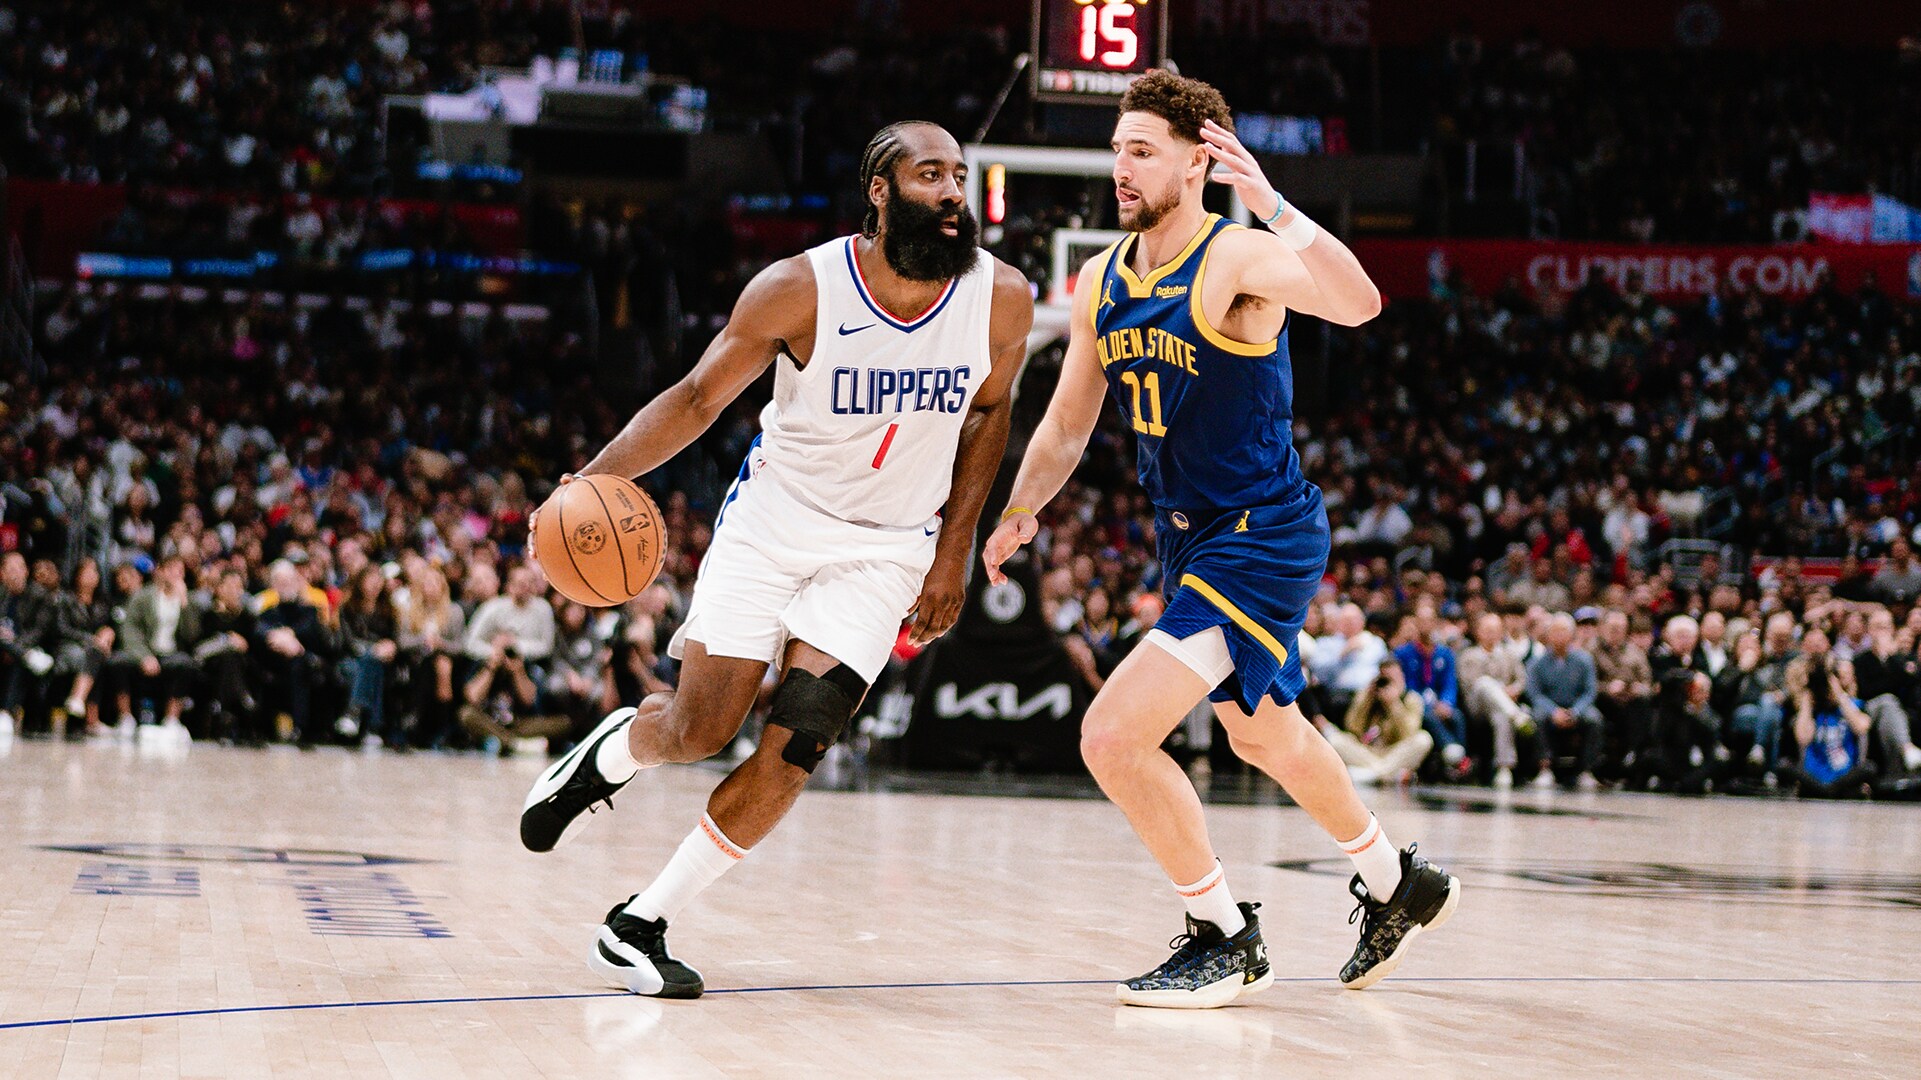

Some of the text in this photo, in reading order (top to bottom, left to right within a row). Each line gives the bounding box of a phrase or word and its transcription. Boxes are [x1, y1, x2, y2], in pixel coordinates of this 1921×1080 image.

[1079, 2, 1138, 67] 15
[1073, 70, 1144, 94] TISS
[1156, 285, 1188, 298] Rakuten
[1527, 255, 1829, 294] CLIPPERSCOM
[1096, 327, 1199, 376] OLDEN STATE
[830, 364, 971, 415] CLIPPERS
[1121, 371, 1168, 437] 11
[871, 423, 900, 470] 1
